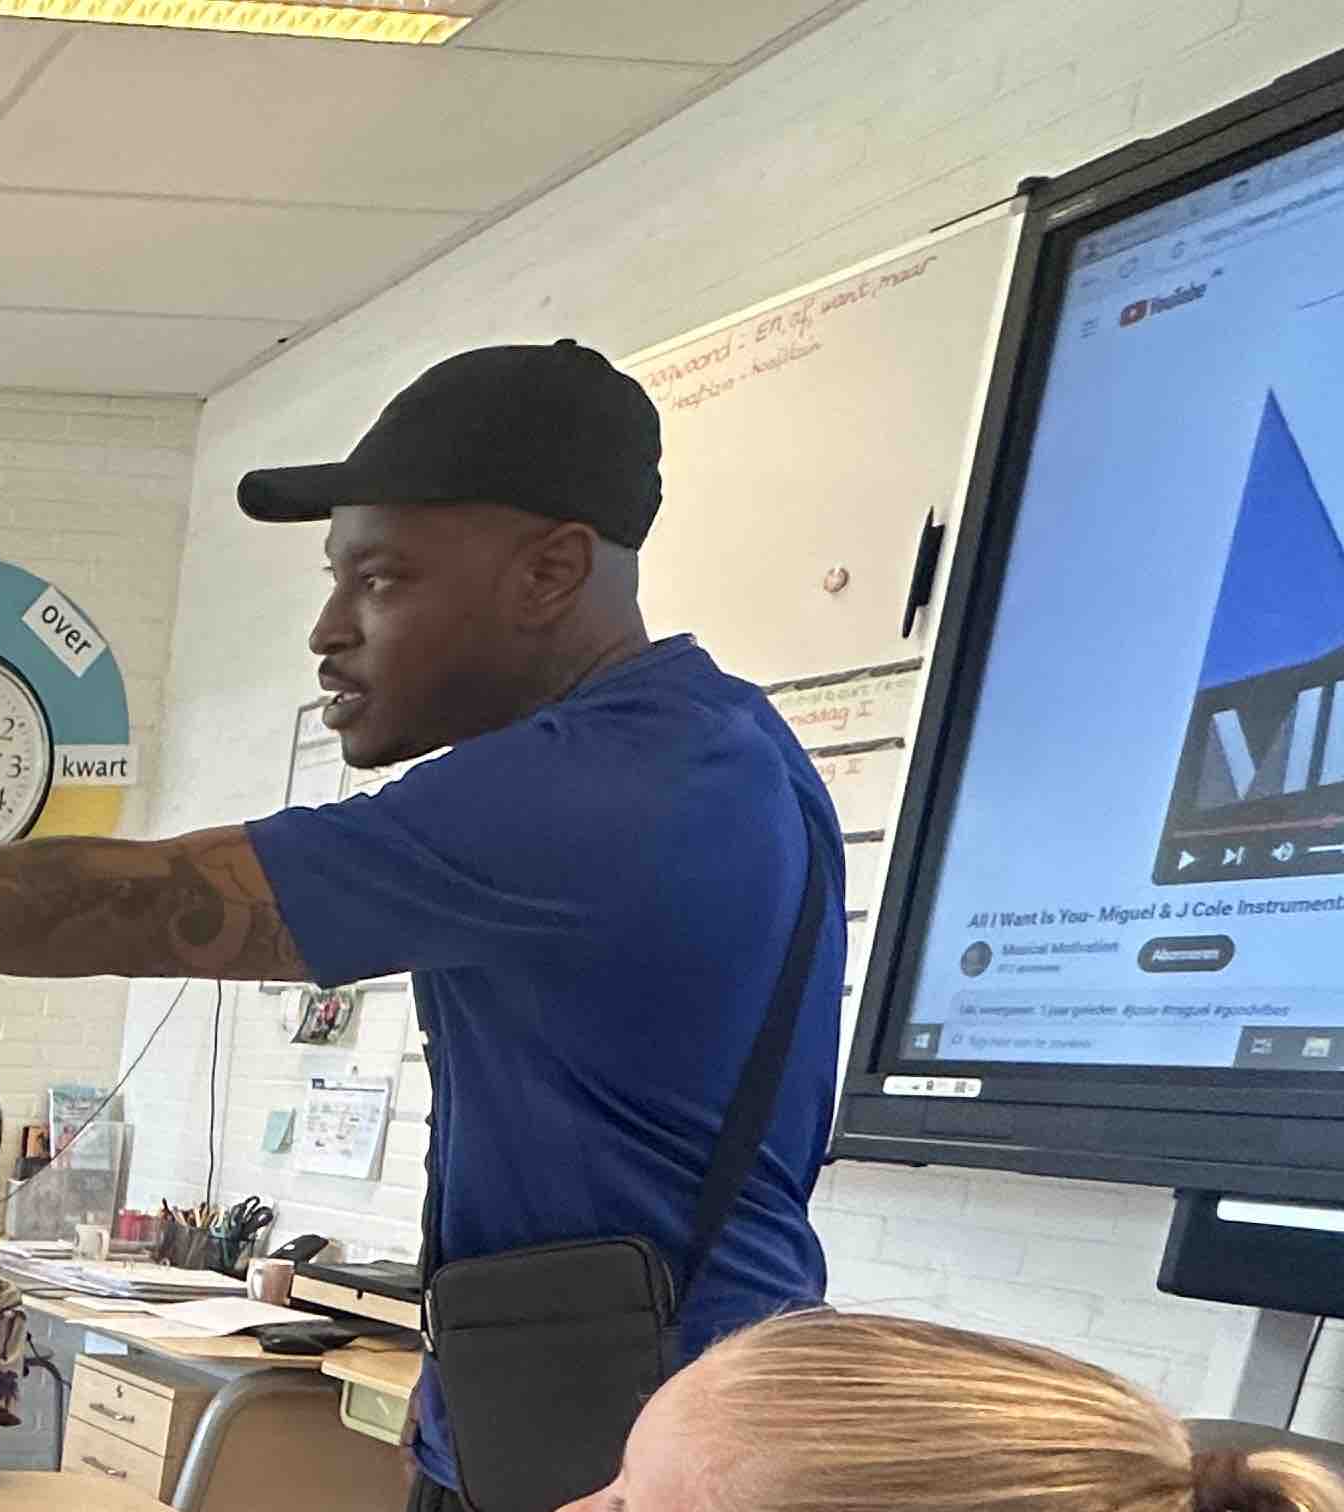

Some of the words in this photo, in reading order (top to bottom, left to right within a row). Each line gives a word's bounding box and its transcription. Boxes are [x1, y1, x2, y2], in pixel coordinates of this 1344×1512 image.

[40, 604, 94, 656] over
[7, 754, 23, 778] 3
[61, 751, 128, 779] kwart
[967, 911, 989, 928] All
[999, 911, 1038, 927] Want
[1040, 910, 1056, 925] Is
[1097, 903, 1154, 925] Miguel
[1158, 902, 1173, 918] &
[1175, 901, 1188, 918] J
[1191, 901, 1234, 917] Cole
